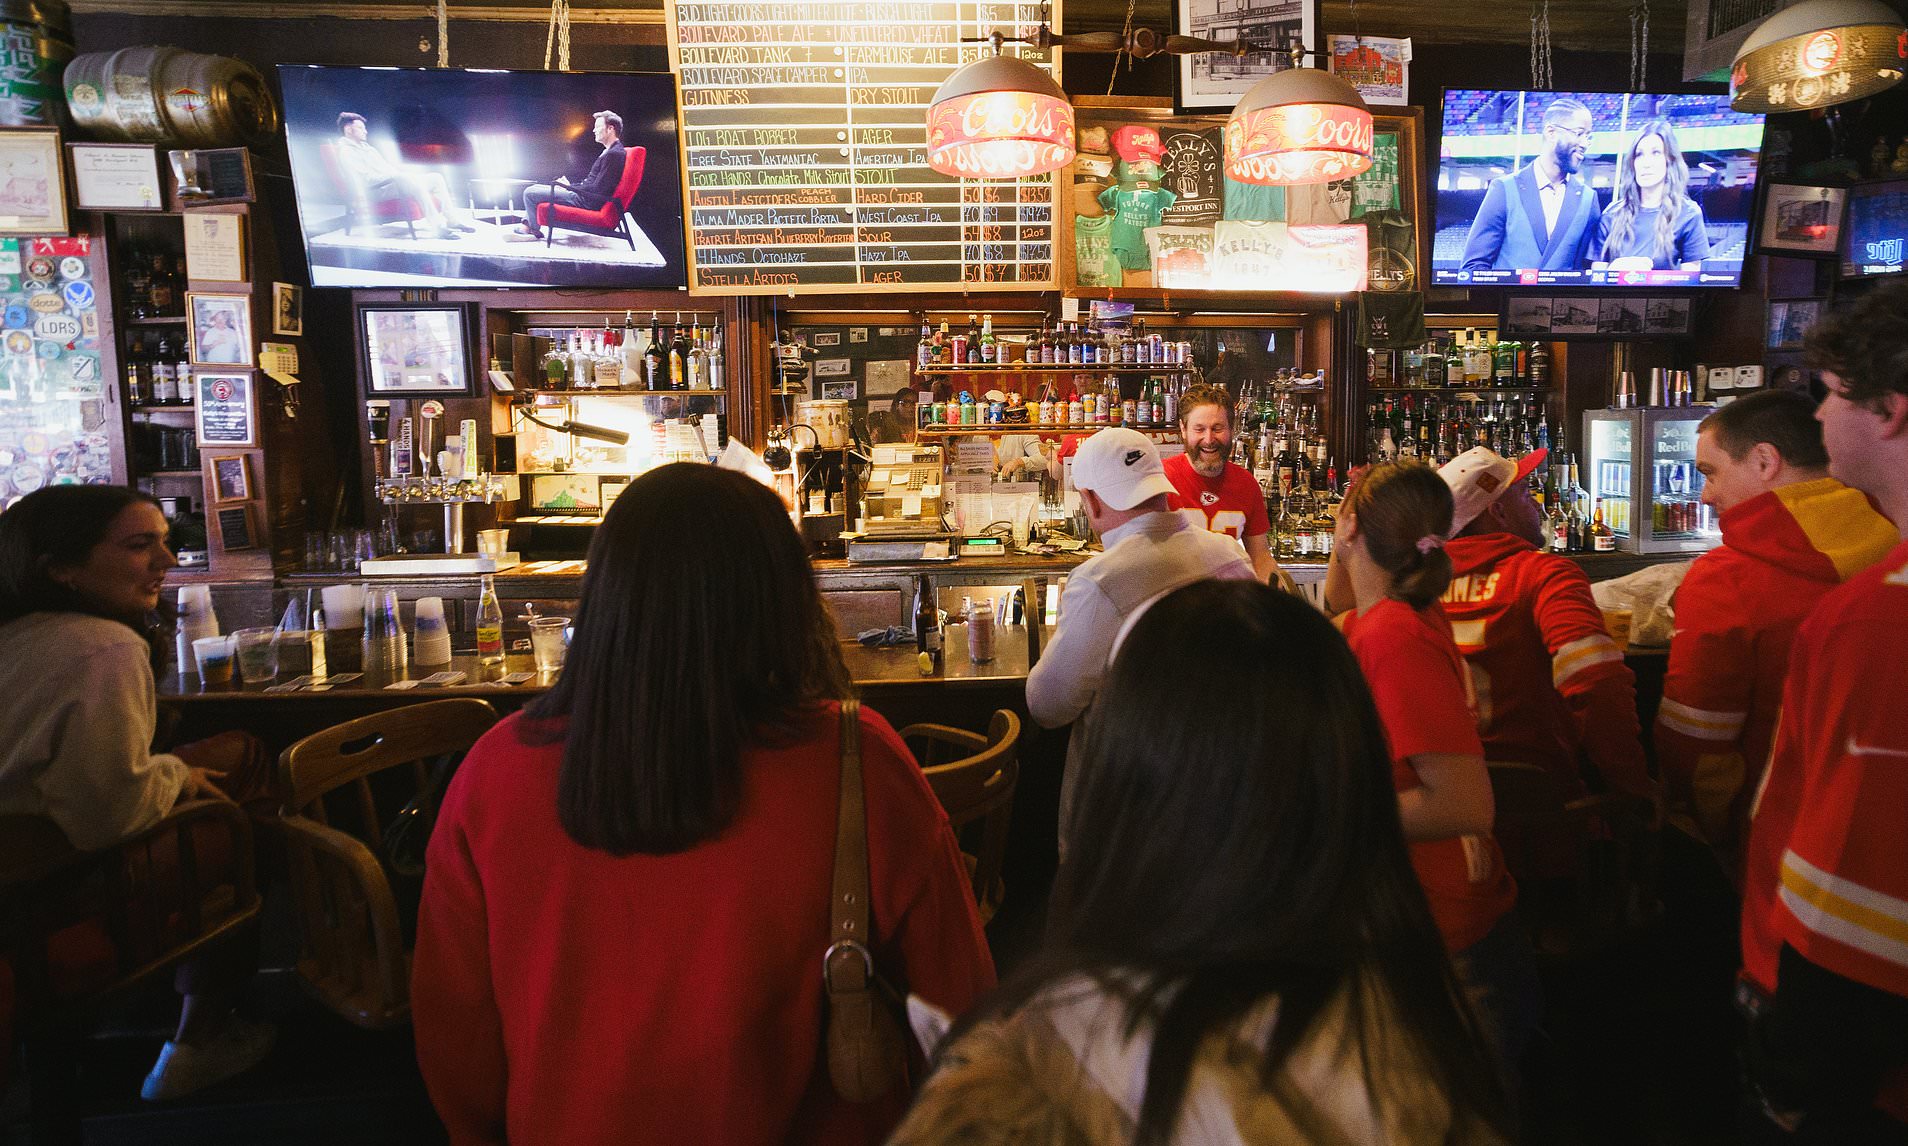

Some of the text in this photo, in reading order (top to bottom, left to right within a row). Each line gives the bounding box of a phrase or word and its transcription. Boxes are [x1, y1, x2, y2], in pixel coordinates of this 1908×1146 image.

[678, 26, 747, 43] BOULEVARD
[752, 25, 785, 42] PALE
[792, 25, 815, 42] ALE
[912, 26, 951, 43] WHEAT
[680, 47, 749, 64] BOULEVARD
[752, 47, 793, 63] TANK
[850, 47, 948, 64] FARMHOUSE ALE
[683, 68, 828, 85] BOULEVARD SPACE CAMPER
[850, 67, 869, 83] IPA
[851, 88, 920, 105] DRY STOUT
[689, 129, 798, 147] LOG BOAT BOBBER
[854, 129, 893, 144] LAGER
[690, 149, 717, 167] FREE
[720, 150, 753, 166] STATE
[855, 149, 927, 164] AMERICAN IPA
[1163, 140, 1217, 173] KELLY'S
[692, 172, 717, 186] FOUR
[758, 170, 800, 186] Chocolate
[803, 170, 823, 185] Milk
[825, 169, 850, 185] Stout
[854, 169, 897, 184] STOUT
[694, 190, 729, 206] AUSTIN
[798, 195, 838, 203] COBBLER
[855, 187, 923, 204] HARD CIDER
[963, 188, 980, 203] 50
[695, 207, 841, 225] ALMA MADER PACIFIC PORTAL
[858, 207, 942, 223] WEST COAST IPA
[735, 229, 773, 245] ARTISAN
[775, 228, 818, 245] BLUEBERRY
[858, 227, 892, 242] SOUR
[710, 248, 746, 264] HANDS
[752, 247, 807, 263] OCTOHAZE
[859, 245, 911, 261] HAZY IPA
[701, 268, 799, 286] STELLA ARTOIS
[862, 267, 903, 283] LAGER
[41, 322, 76, 335] LDRS
[1658, 442, 1681, 453] Red
